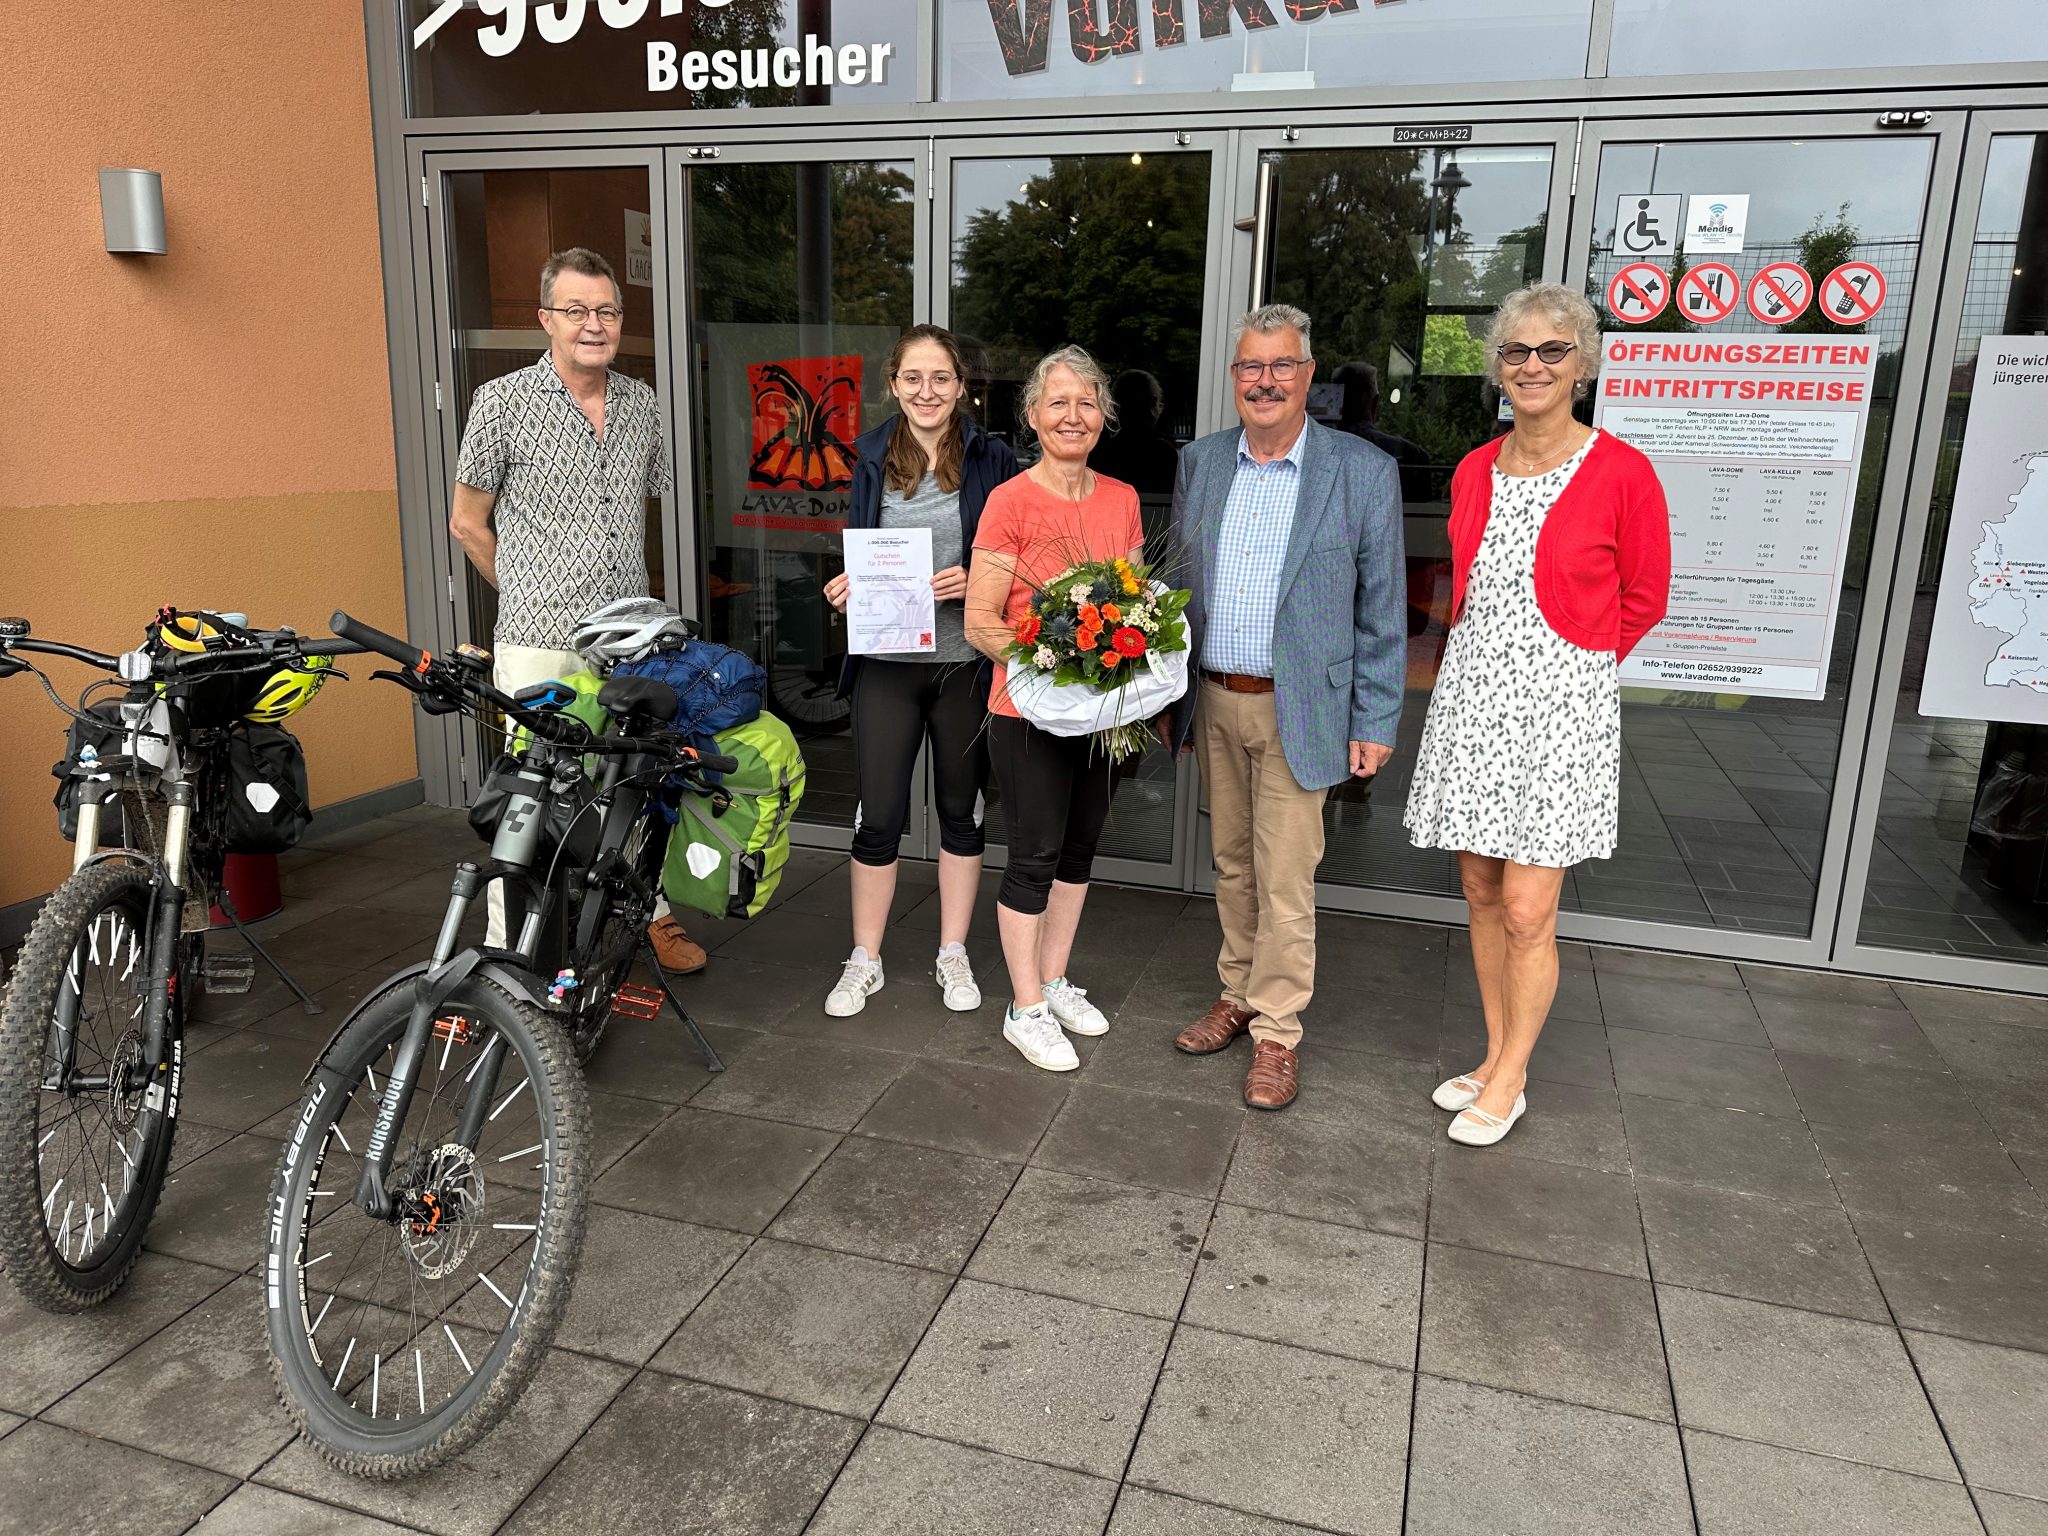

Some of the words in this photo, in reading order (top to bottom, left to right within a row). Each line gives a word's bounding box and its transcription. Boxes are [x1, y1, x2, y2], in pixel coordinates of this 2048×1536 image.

[646, 34, 890, 92] Besucher
[1698, 225, 1733, 233] Mendig
[1608, 339, 1870, 366] ÖFFNUNGSZEITEN
[1997, 354, 2019, 366] Die
[1604, 378, 1864, 402] EINTRITTSPREISE
[1686, 410, 1734, 418] Öffnungszeiten
[741, 495, 850, 517] LAVA-DOM
[1674, 574, 1726, 583] Kellerführungen
[1737, 577, 1775, 585] Tagesgäste
[1660, 621, 1694, 629] Führungen
[1708, 616, 1740, 624] Personen
[2007, 654, 2038, 662] Kaiserstuhl
[1641, 659, 1696, 671] Info-Telefon
[1697, 663, 1763, 675] 02652/9399222
[1660, 671, 1741, 683] www.lavadome.de
[366, 1078, 405, 1162] ROCKSHOX
